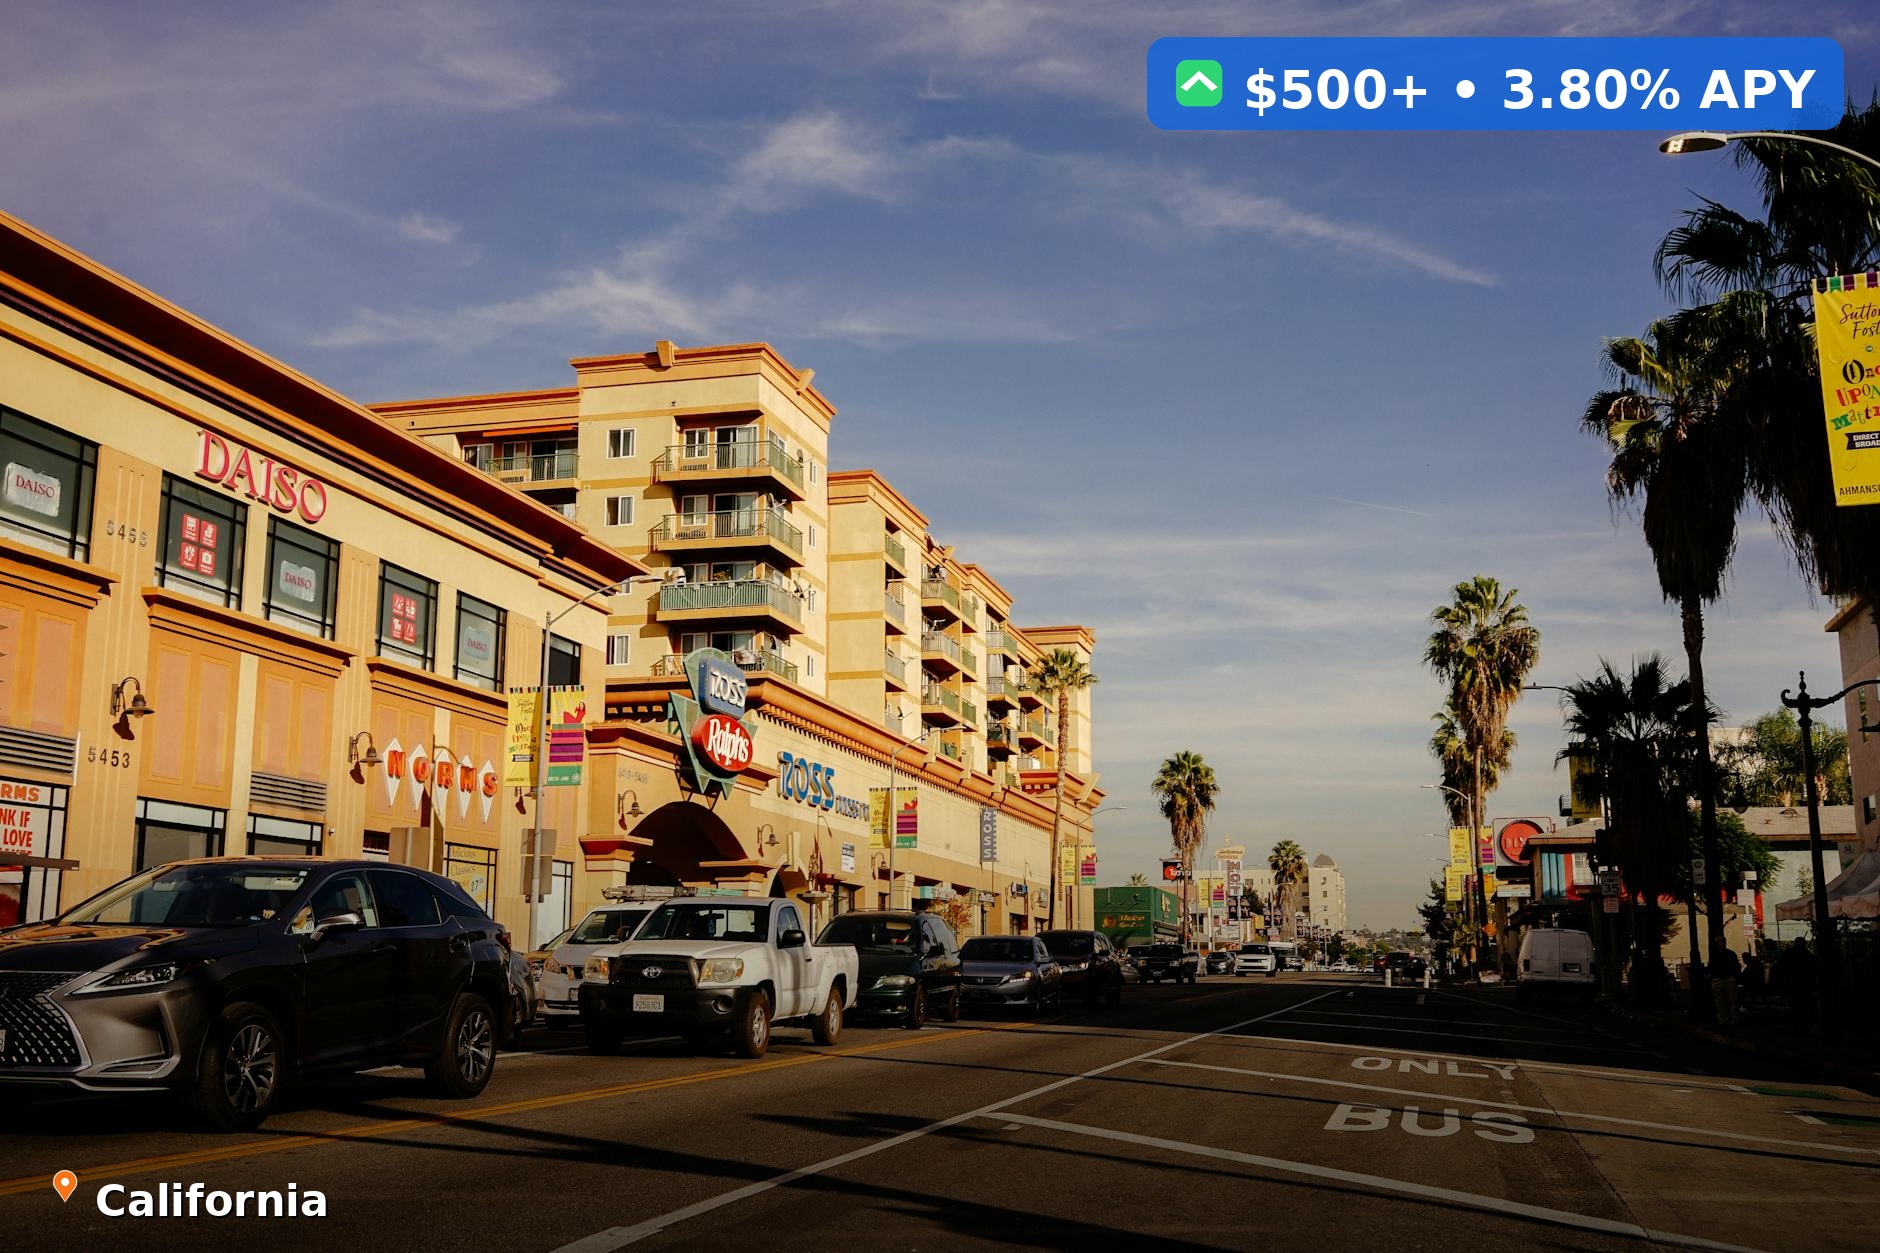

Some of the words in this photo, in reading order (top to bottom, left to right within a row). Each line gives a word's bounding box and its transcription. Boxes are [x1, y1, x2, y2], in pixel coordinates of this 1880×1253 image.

[1840, 302, 1880, 324] Sutto
[1853, 432, 1880, 443] DIRECT
[15, 474, 56, 499] DAISO
[194, 429, 327, 524] DAISO
[284, 570, 312, 590] DAISO
[467, 638, 487, 652] DAISO
[710, 667, 745, 707] ROSS
[707, 718, 750, 767] Ralphs
[87, 745, 130, 769] 5453
[387, 749, 498, 798] NORMS
[777, 751, 835, 811] ROSS
[20, 811, 31, 828] IF
[3, 829, 33, 848] LOVE
[983, 811, 992, 858] ROSS
[1350, 1056, 1520, 1081] ONLY
[1324, 1103, 1536, 1144] BUS
